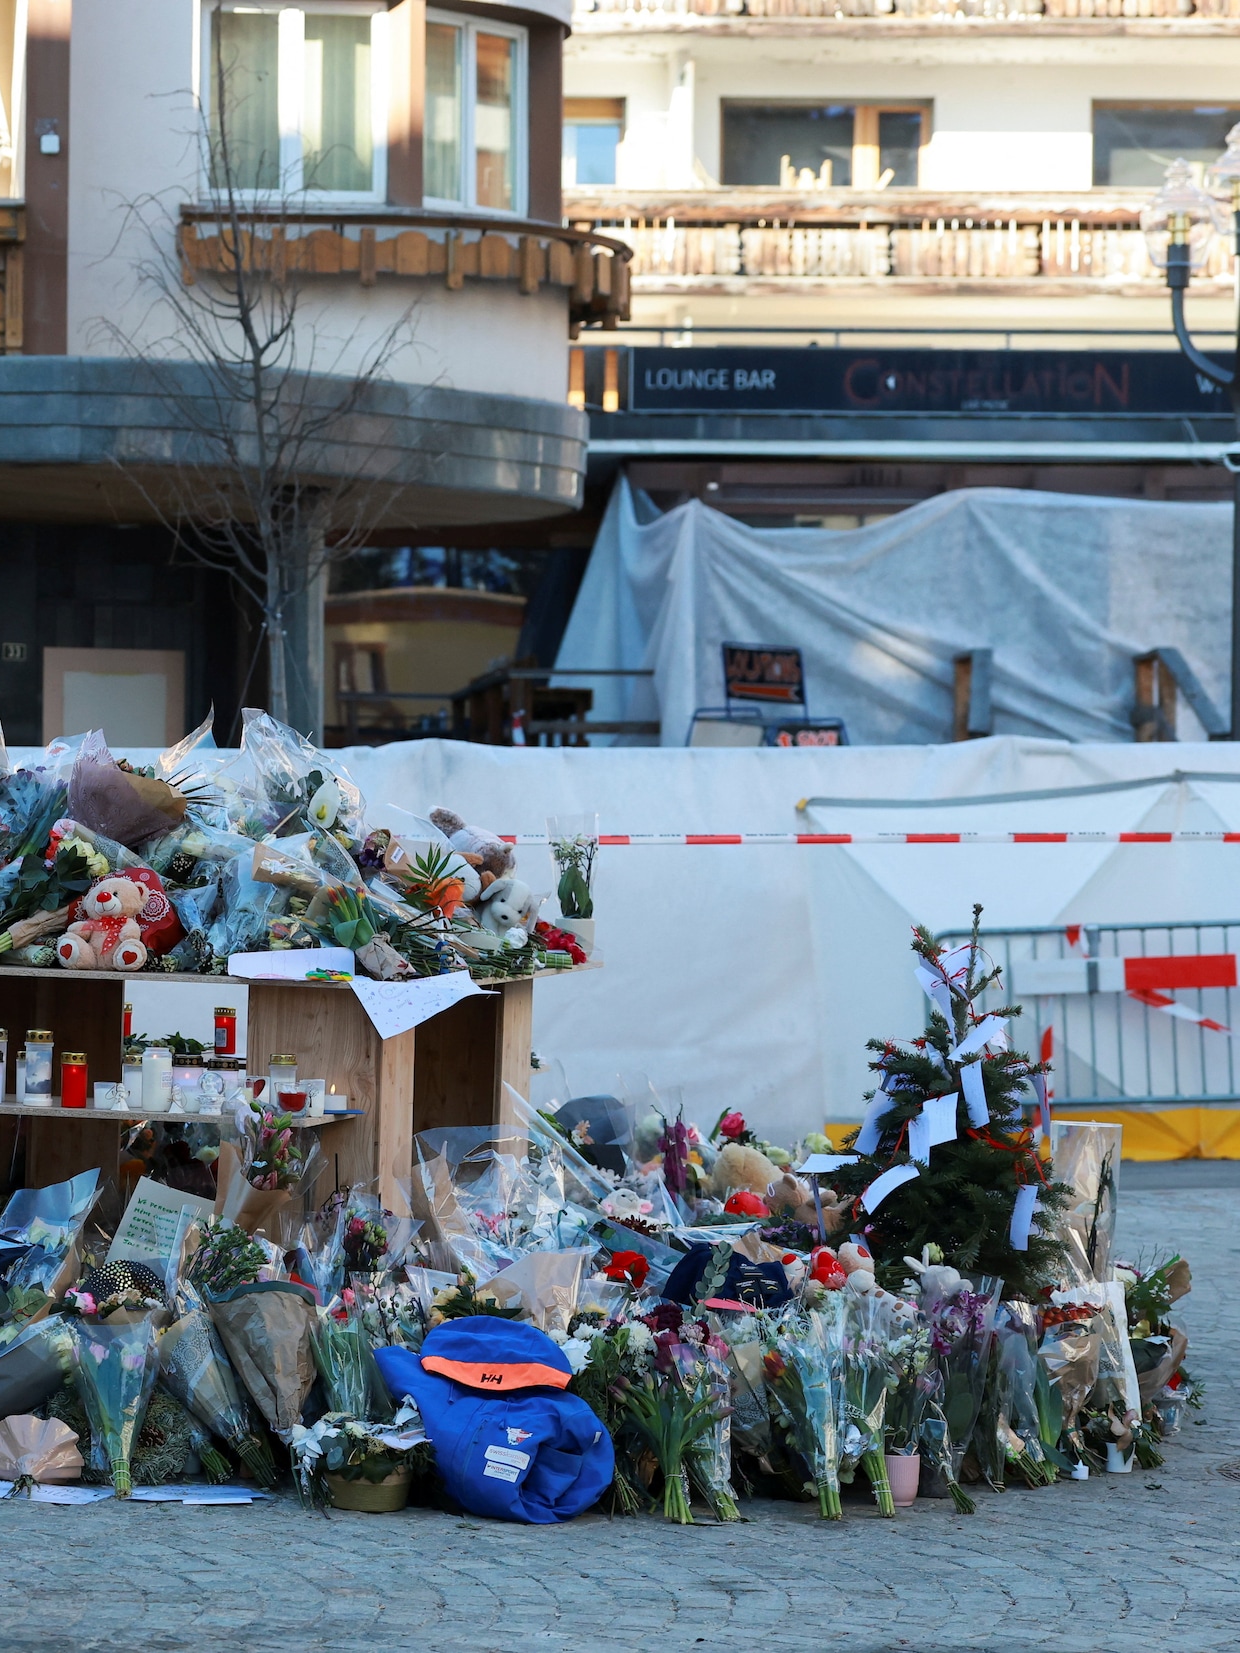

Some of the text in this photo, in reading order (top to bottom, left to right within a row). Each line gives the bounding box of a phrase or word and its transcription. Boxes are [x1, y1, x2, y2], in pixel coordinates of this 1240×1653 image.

[645, 368, 776, 390] LOUNGE BAR
[480, 1373, 503, 1385] HH
